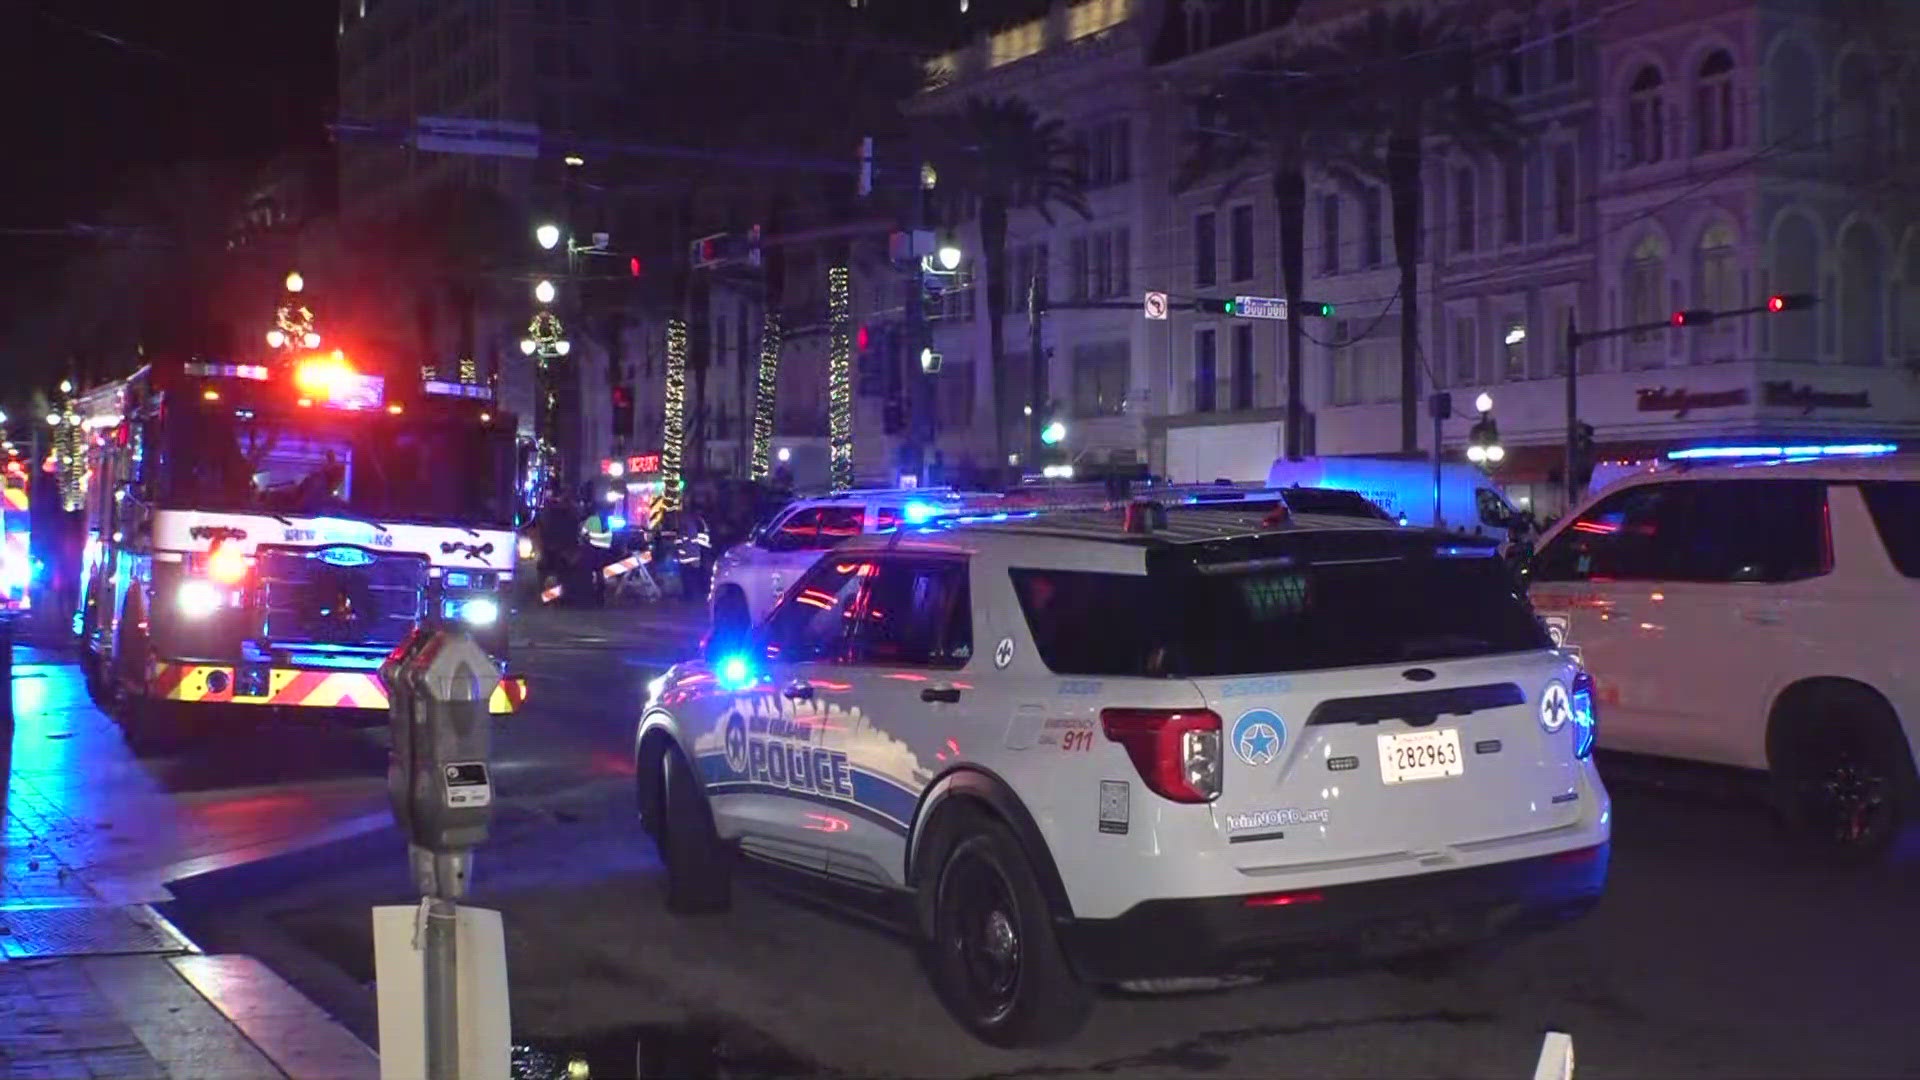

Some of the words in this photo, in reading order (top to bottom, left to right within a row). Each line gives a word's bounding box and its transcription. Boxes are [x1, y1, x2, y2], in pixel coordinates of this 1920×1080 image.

[1244, 299, 1286, 317] Bourbon
[1062, 730, 1094, 752] 911
[1396, 742, 1457, 770] 282963
[748, 738, 855, 801] POLICE
